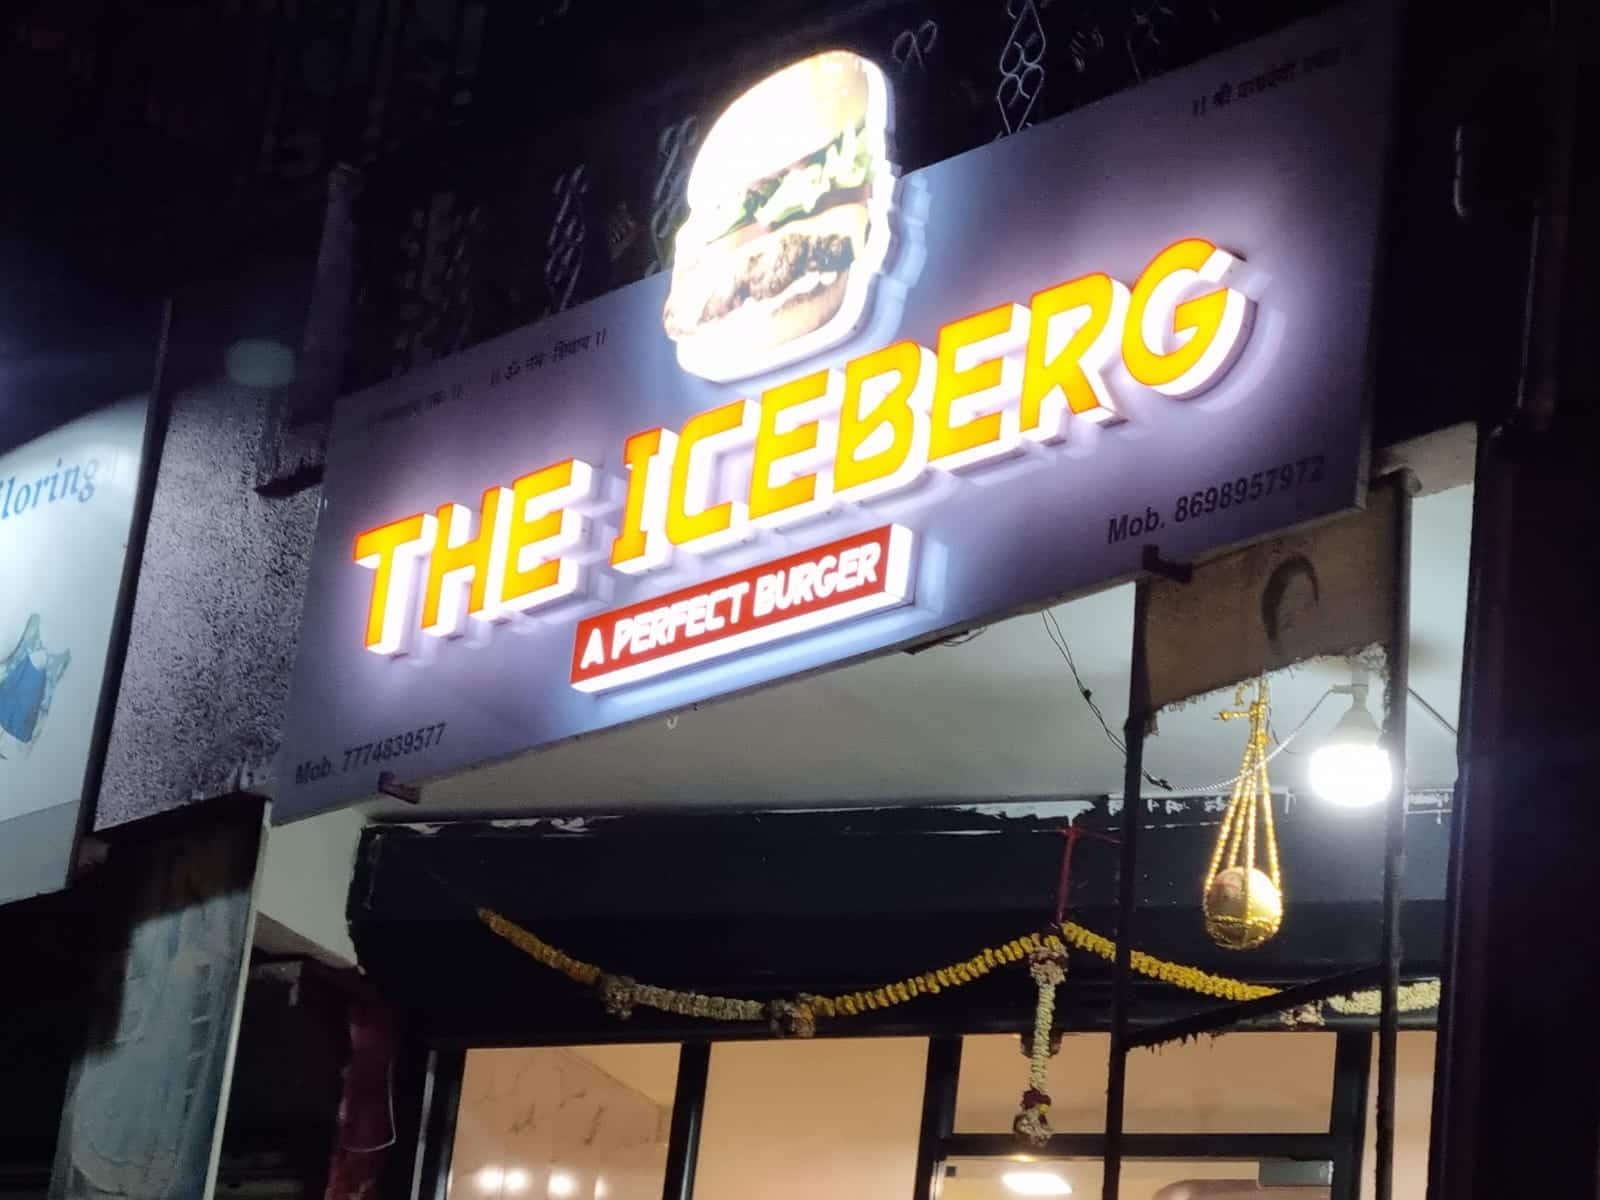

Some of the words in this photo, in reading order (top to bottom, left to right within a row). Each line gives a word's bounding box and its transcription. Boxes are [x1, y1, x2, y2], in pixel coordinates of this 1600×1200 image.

[0, 457, 98, 520] loring
[353, 459, 582, 655] THE
[610, 237, 1240, 570] ICEBERG
[1107, 506, 1166, 544] Mob.
[579, 627, 605, 670] A
[611, 582, 749, 660] PERFECT
[753, 541, 882, 617] BURGER
